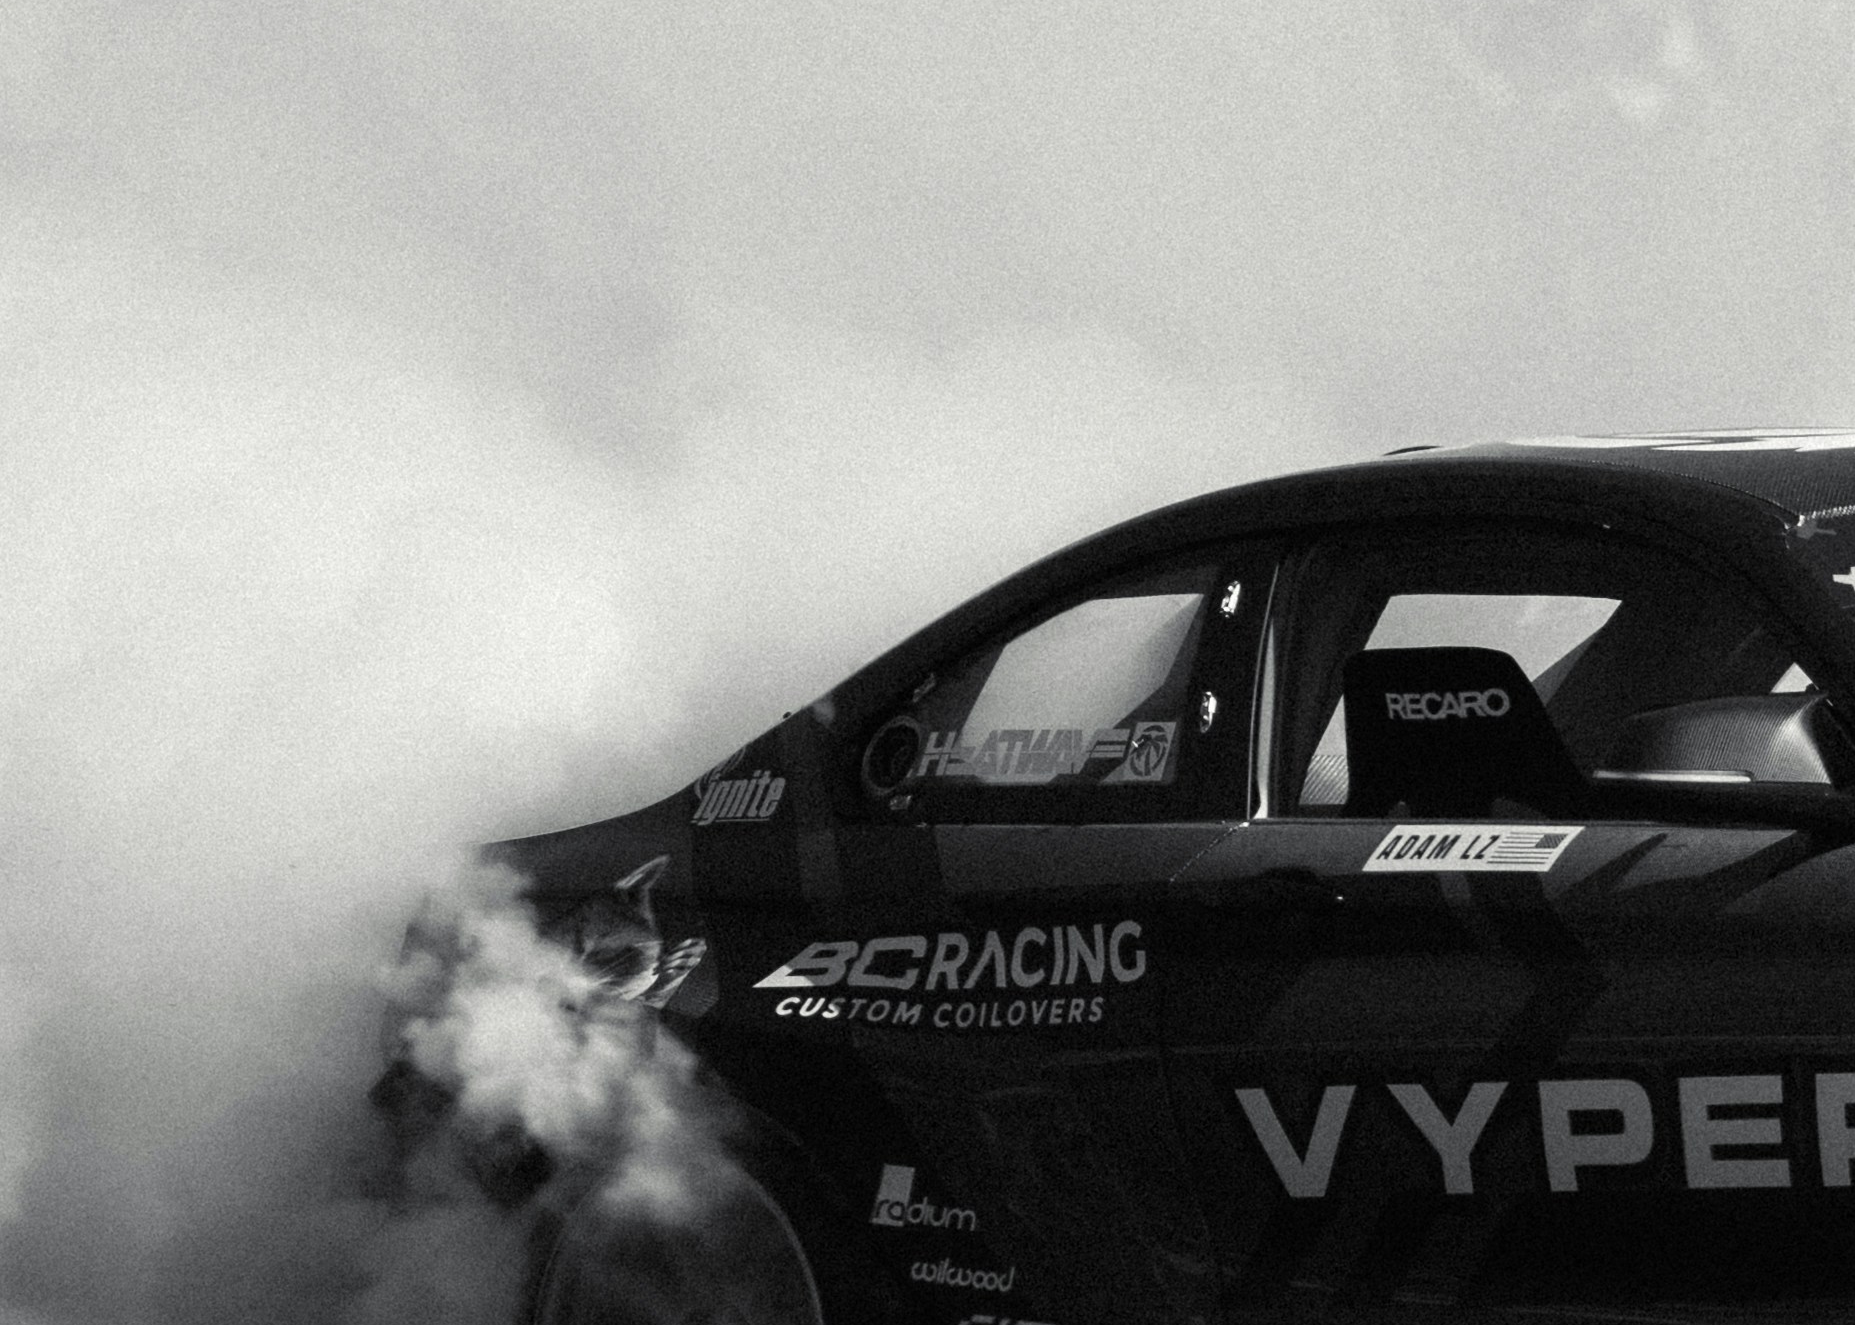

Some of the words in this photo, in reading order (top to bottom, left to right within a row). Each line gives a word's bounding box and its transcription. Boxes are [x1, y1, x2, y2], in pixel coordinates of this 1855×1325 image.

[1385, 688, 1511, 721] RECARO
[1376, 834, 1461, 860] ADAM
[1459, 834, 1501, 860] LZ
[925, 920, 1146, 991] RACING
[774, 996, 923, 1025] CUSTOM
[933, 996, 1105, 1028] COILOVERS
[874, 1196, 977, 1231] radium
[910, 1257, 1015, 1292] wilwood
